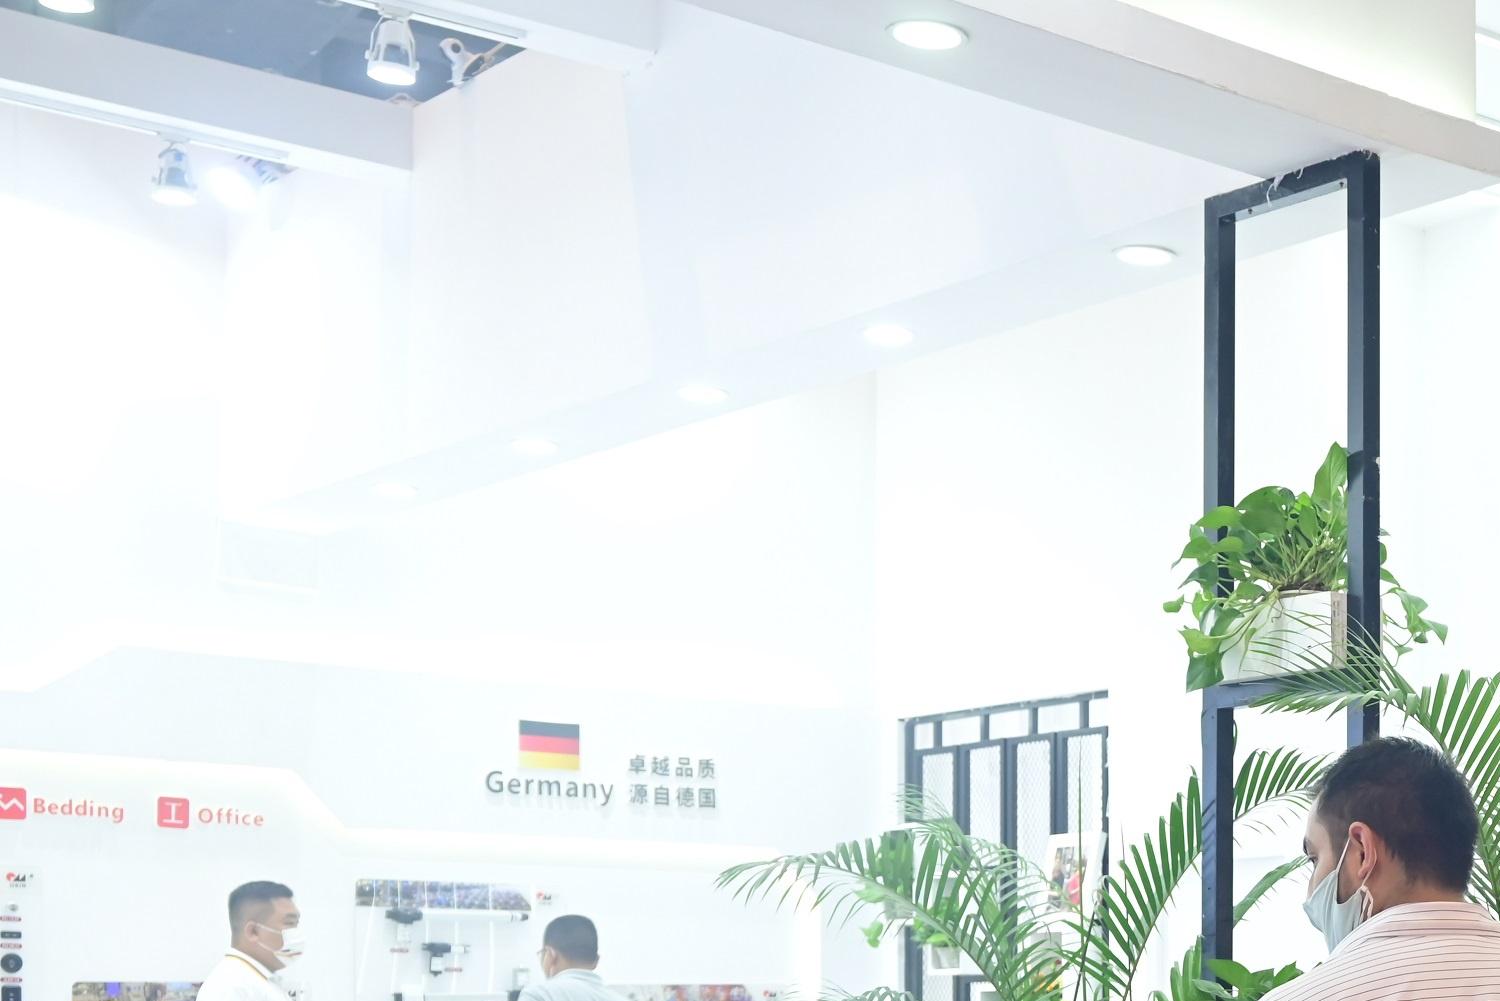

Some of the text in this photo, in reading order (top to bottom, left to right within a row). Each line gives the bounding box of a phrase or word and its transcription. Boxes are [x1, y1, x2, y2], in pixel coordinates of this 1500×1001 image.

[628, 754, 716, 780] 卓越品质
[485, 770, 614, 806] Germany
[629, 783, 717, 808] 源自德国
[33, 797, 124, 824] Bedding
[198, 807, 264, 826] Office
